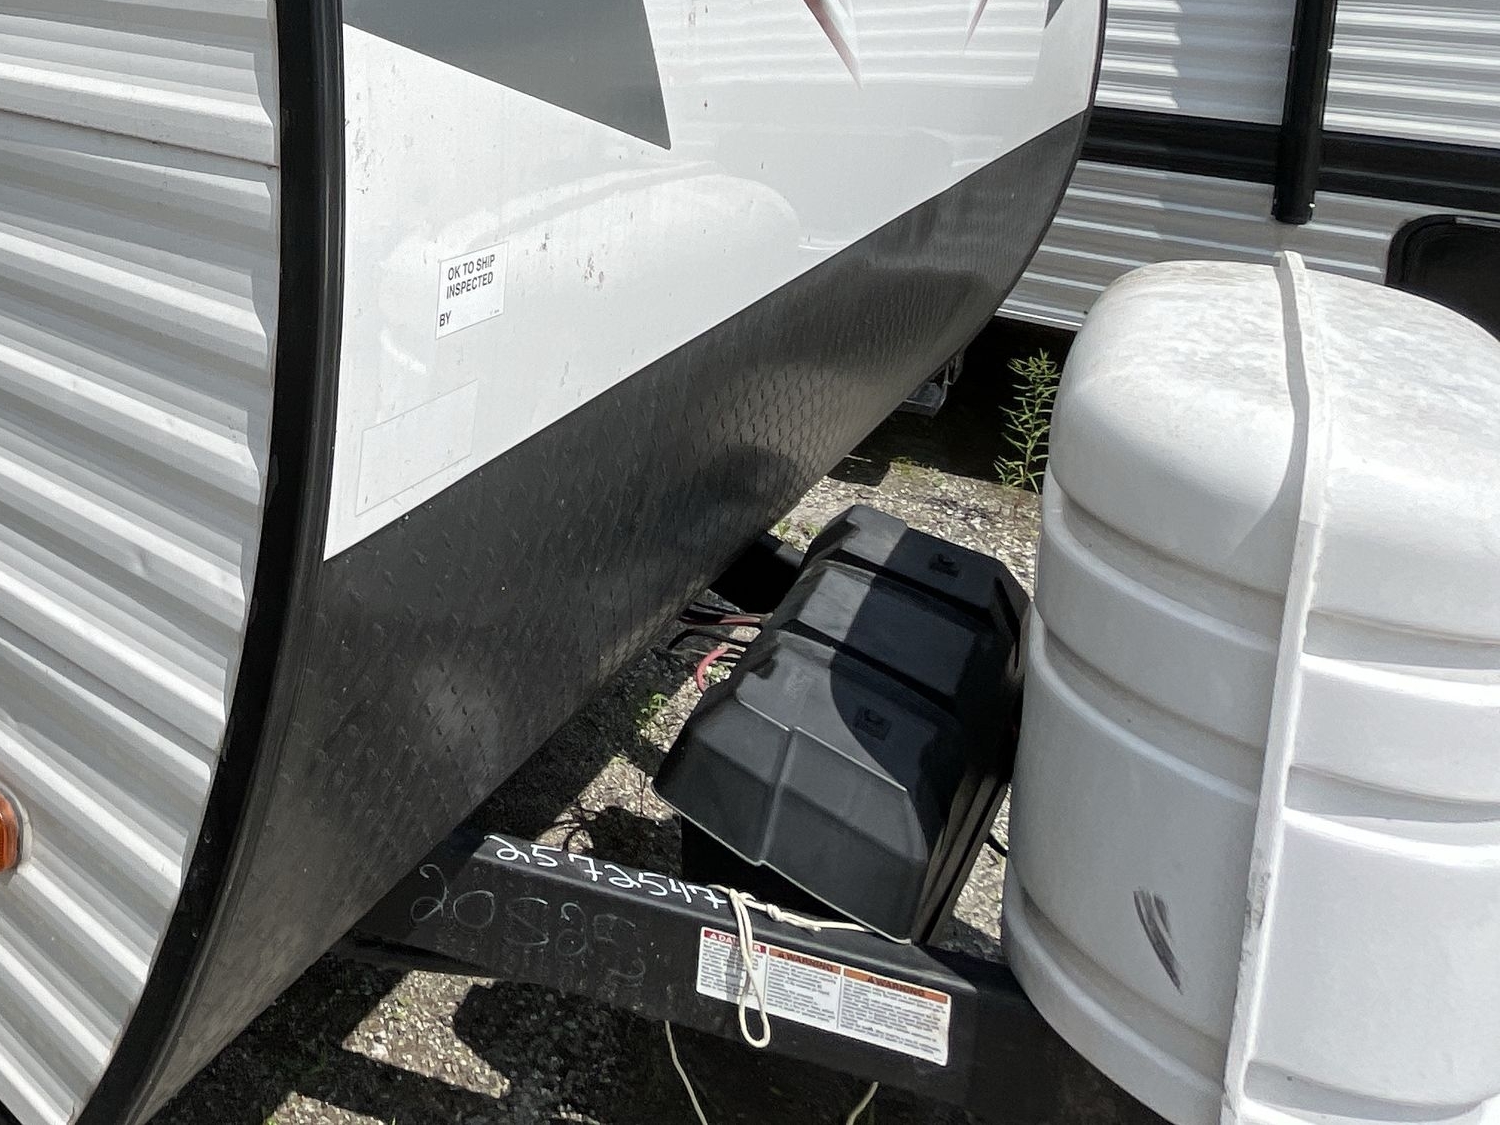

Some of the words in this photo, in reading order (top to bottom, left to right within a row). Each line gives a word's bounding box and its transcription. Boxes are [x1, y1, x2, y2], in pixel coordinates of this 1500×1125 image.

[447, 265, 461, 281] OK
[462, 260, 475, 276] TO
[475, 254, 495, 272] SHIP
[446, 271, 494, 299] INSPECTED
[439, 310, 452, 327] BY
[718, 934, 762, 952] DAR
[875, 977, 925, 997] WARNING
